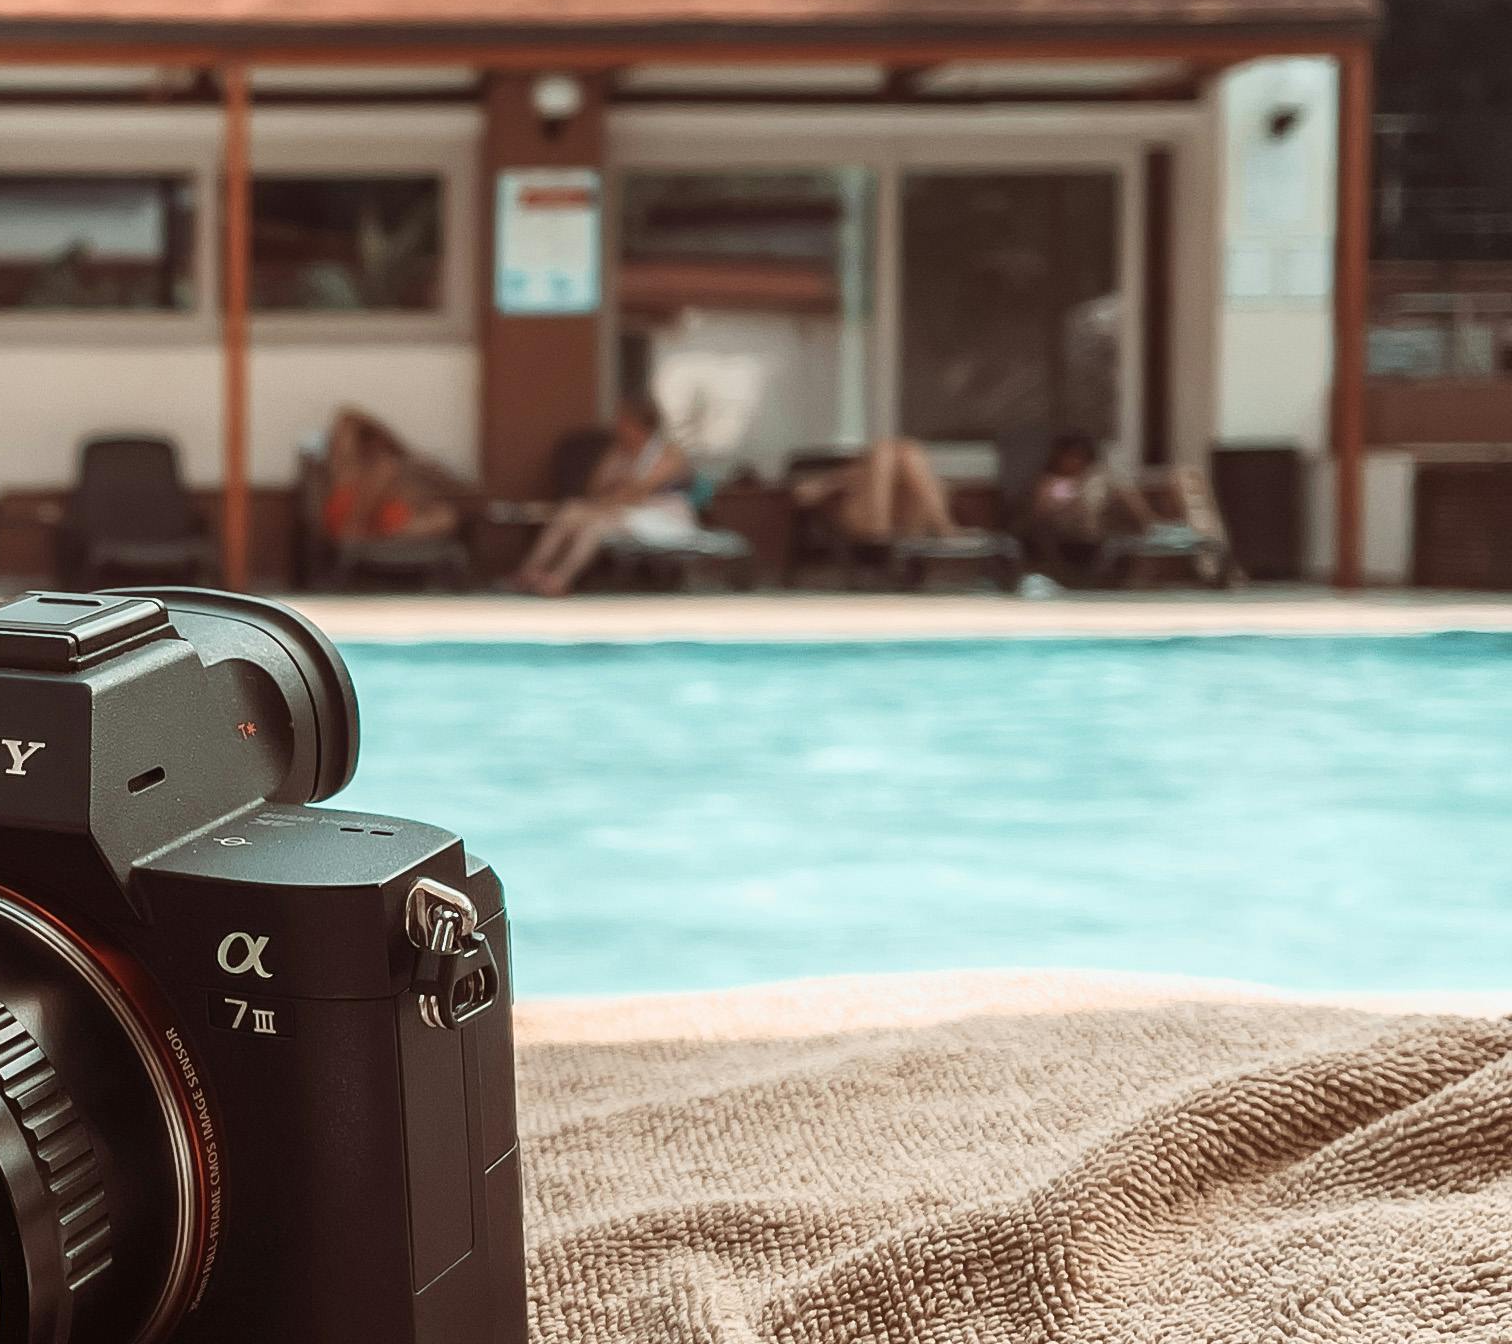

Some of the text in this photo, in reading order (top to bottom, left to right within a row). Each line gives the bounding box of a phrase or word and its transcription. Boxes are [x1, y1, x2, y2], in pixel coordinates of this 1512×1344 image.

[165, 1026, 200, 1088] SENSOR
[191, 1088, 216, 1141] IMAGE
[205, 1141, 221, 1186] CMOS
[202, 1186, 221, 1274] FULL-FRAME
